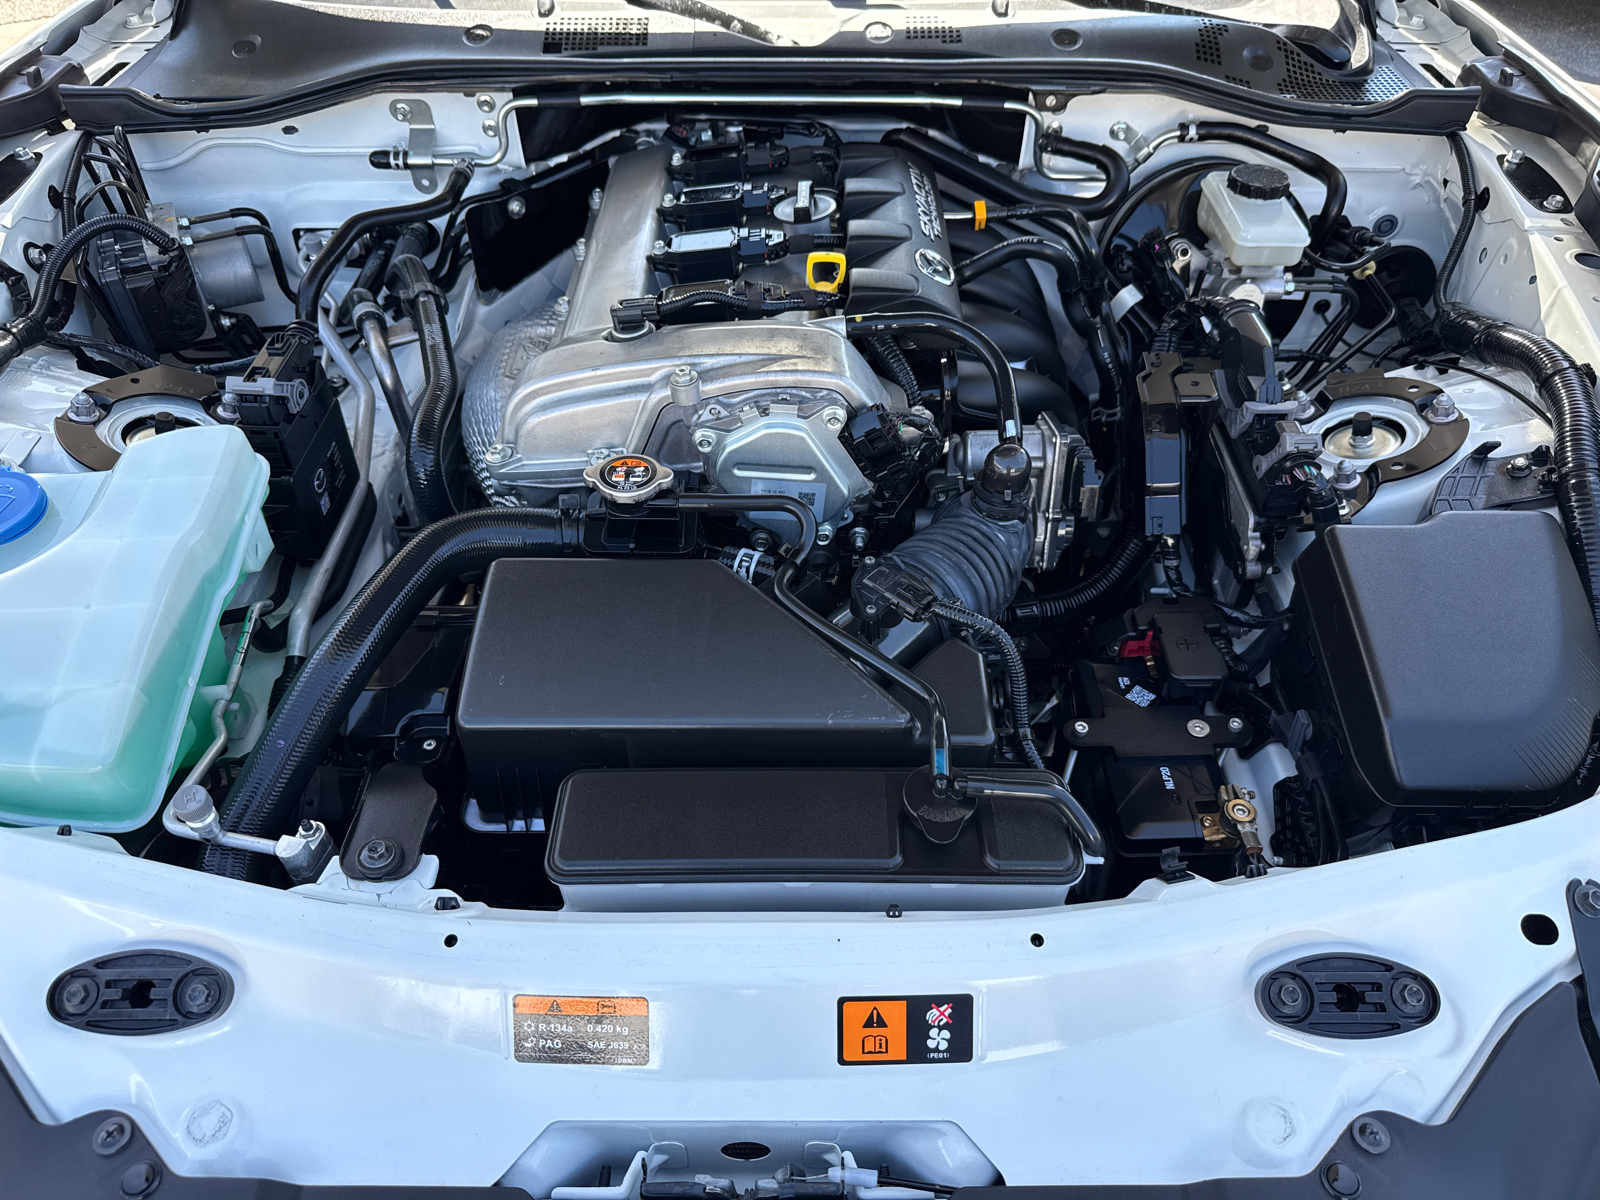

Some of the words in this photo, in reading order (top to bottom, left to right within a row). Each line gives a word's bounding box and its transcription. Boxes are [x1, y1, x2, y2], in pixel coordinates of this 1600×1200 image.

[906, 161, 935, 242] SKYACTIV
[921, 172, 943, 239] TECHNOLOGY
[1159, 766, 1176, 790] NLP20
[538, 1023, 573, 1033] R-134a
[587, 1024, 614, 1033] 0.420
[616, 1024, 629, 1036] kg
[539, 1039, 562, 1049] PAG
[587, 1041, 606, 1049] SAE
[607, 1041, 629, 1050] J639
